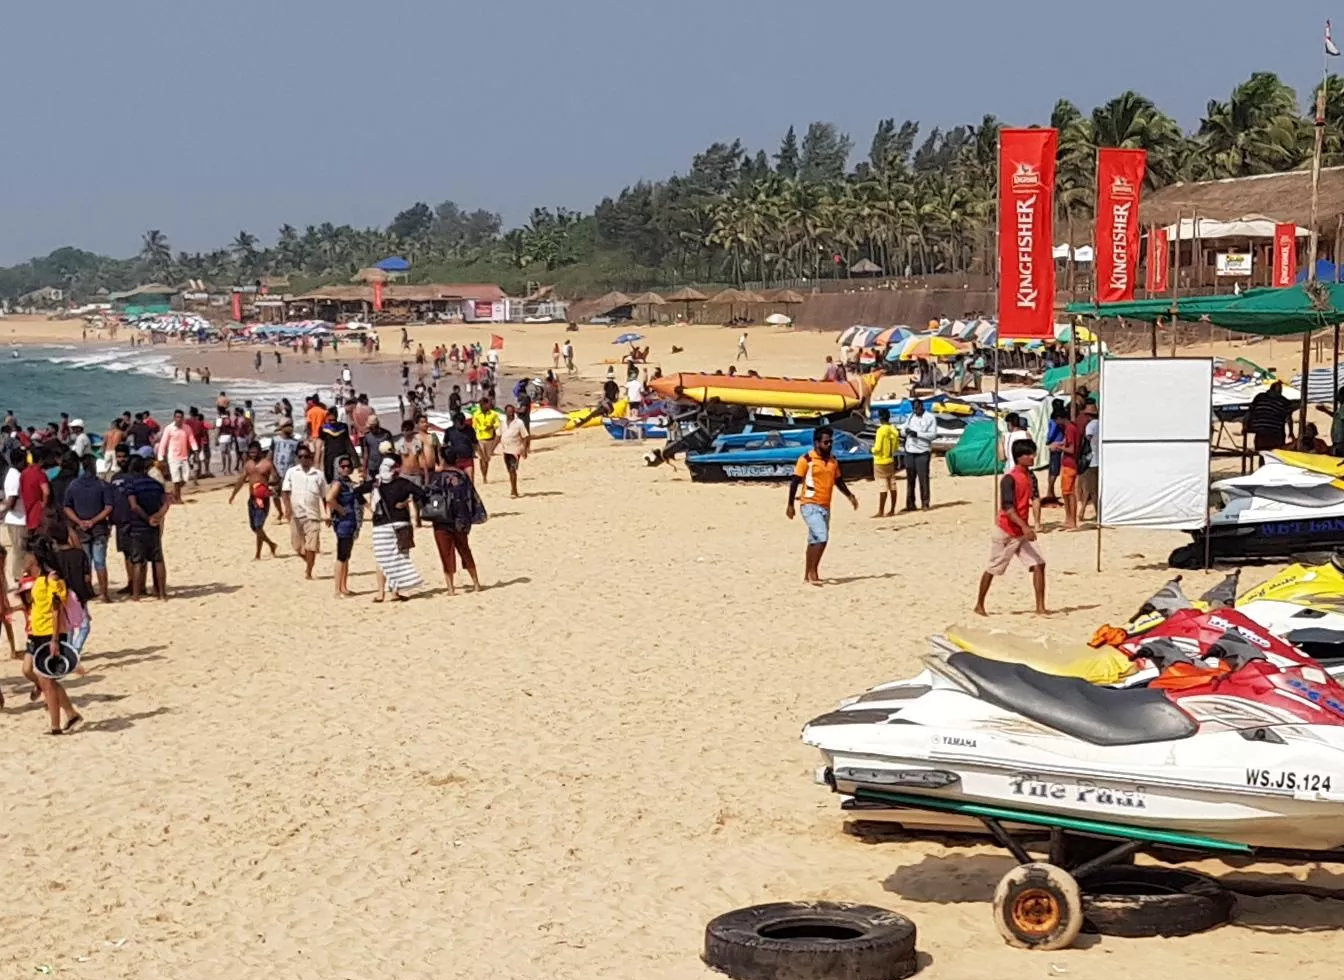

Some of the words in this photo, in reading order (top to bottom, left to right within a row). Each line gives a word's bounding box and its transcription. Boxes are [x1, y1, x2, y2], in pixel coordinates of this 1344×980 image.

[1016, 194, 1038, 310] KINGFISHER
[1110, 201, 1131, 290] KINGFISHER
[942, 736, 977, 749] YAMAHA
[1008, 770, 1067, 800] The
[1245, 767, 1332, 792] WS.JS.124
